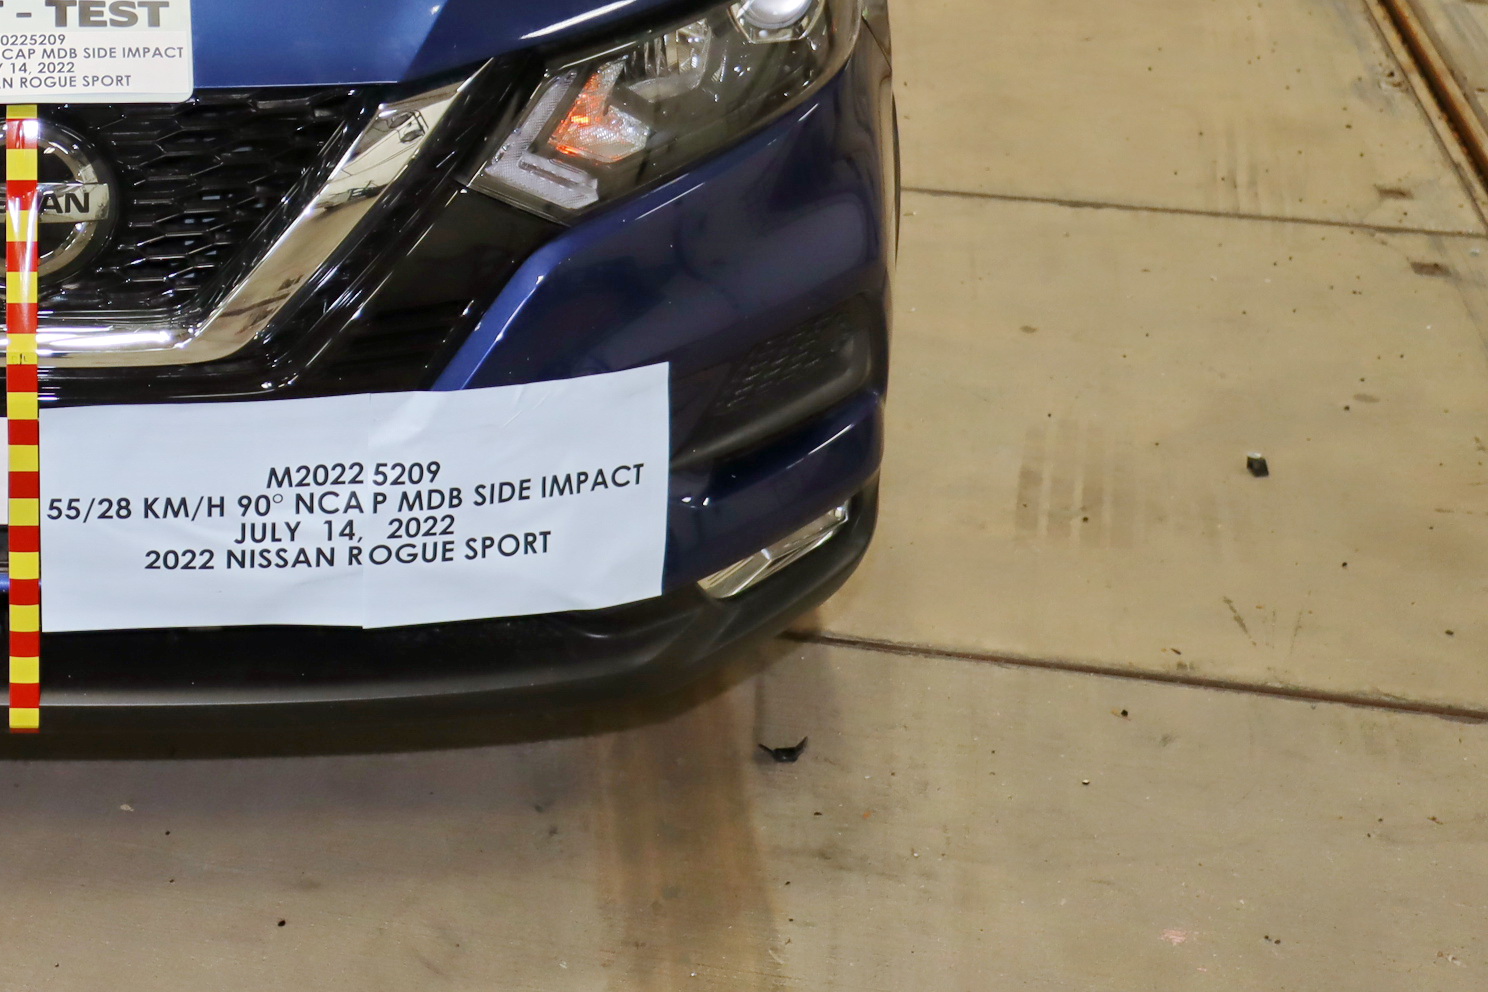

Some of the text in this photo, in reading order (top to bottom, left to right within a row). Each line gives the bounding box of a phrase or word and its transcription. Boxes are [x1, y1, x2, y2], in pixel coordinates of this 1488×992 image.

[45, 0, 169, 27] TEST
[42, 48, 77, 59] MDB
[84, 48, 116, 58] SIDE
[123, 47, 183, 57] IMPACT
[11, 63, 32, 75] 14,
[38, 62, 74, 73] 2022
[20, 76, 76, 88] ROGUE
[83, 75, 131, 86] SPORT
[47, 498, 131, 523] 55/28
[144, 496, 224, 521] KM/H
[238, 494, 283, 517] 90°
[398, 487, 462, 512] MDB
[473, 479, 531, 506] SIDE
[542, 463, 644, 498] IMPACT
[234, 514, 454, 547] JULY 14, 2022
[145, 531, 551, 570] 2022 NISSAN ROGUE SPORT
